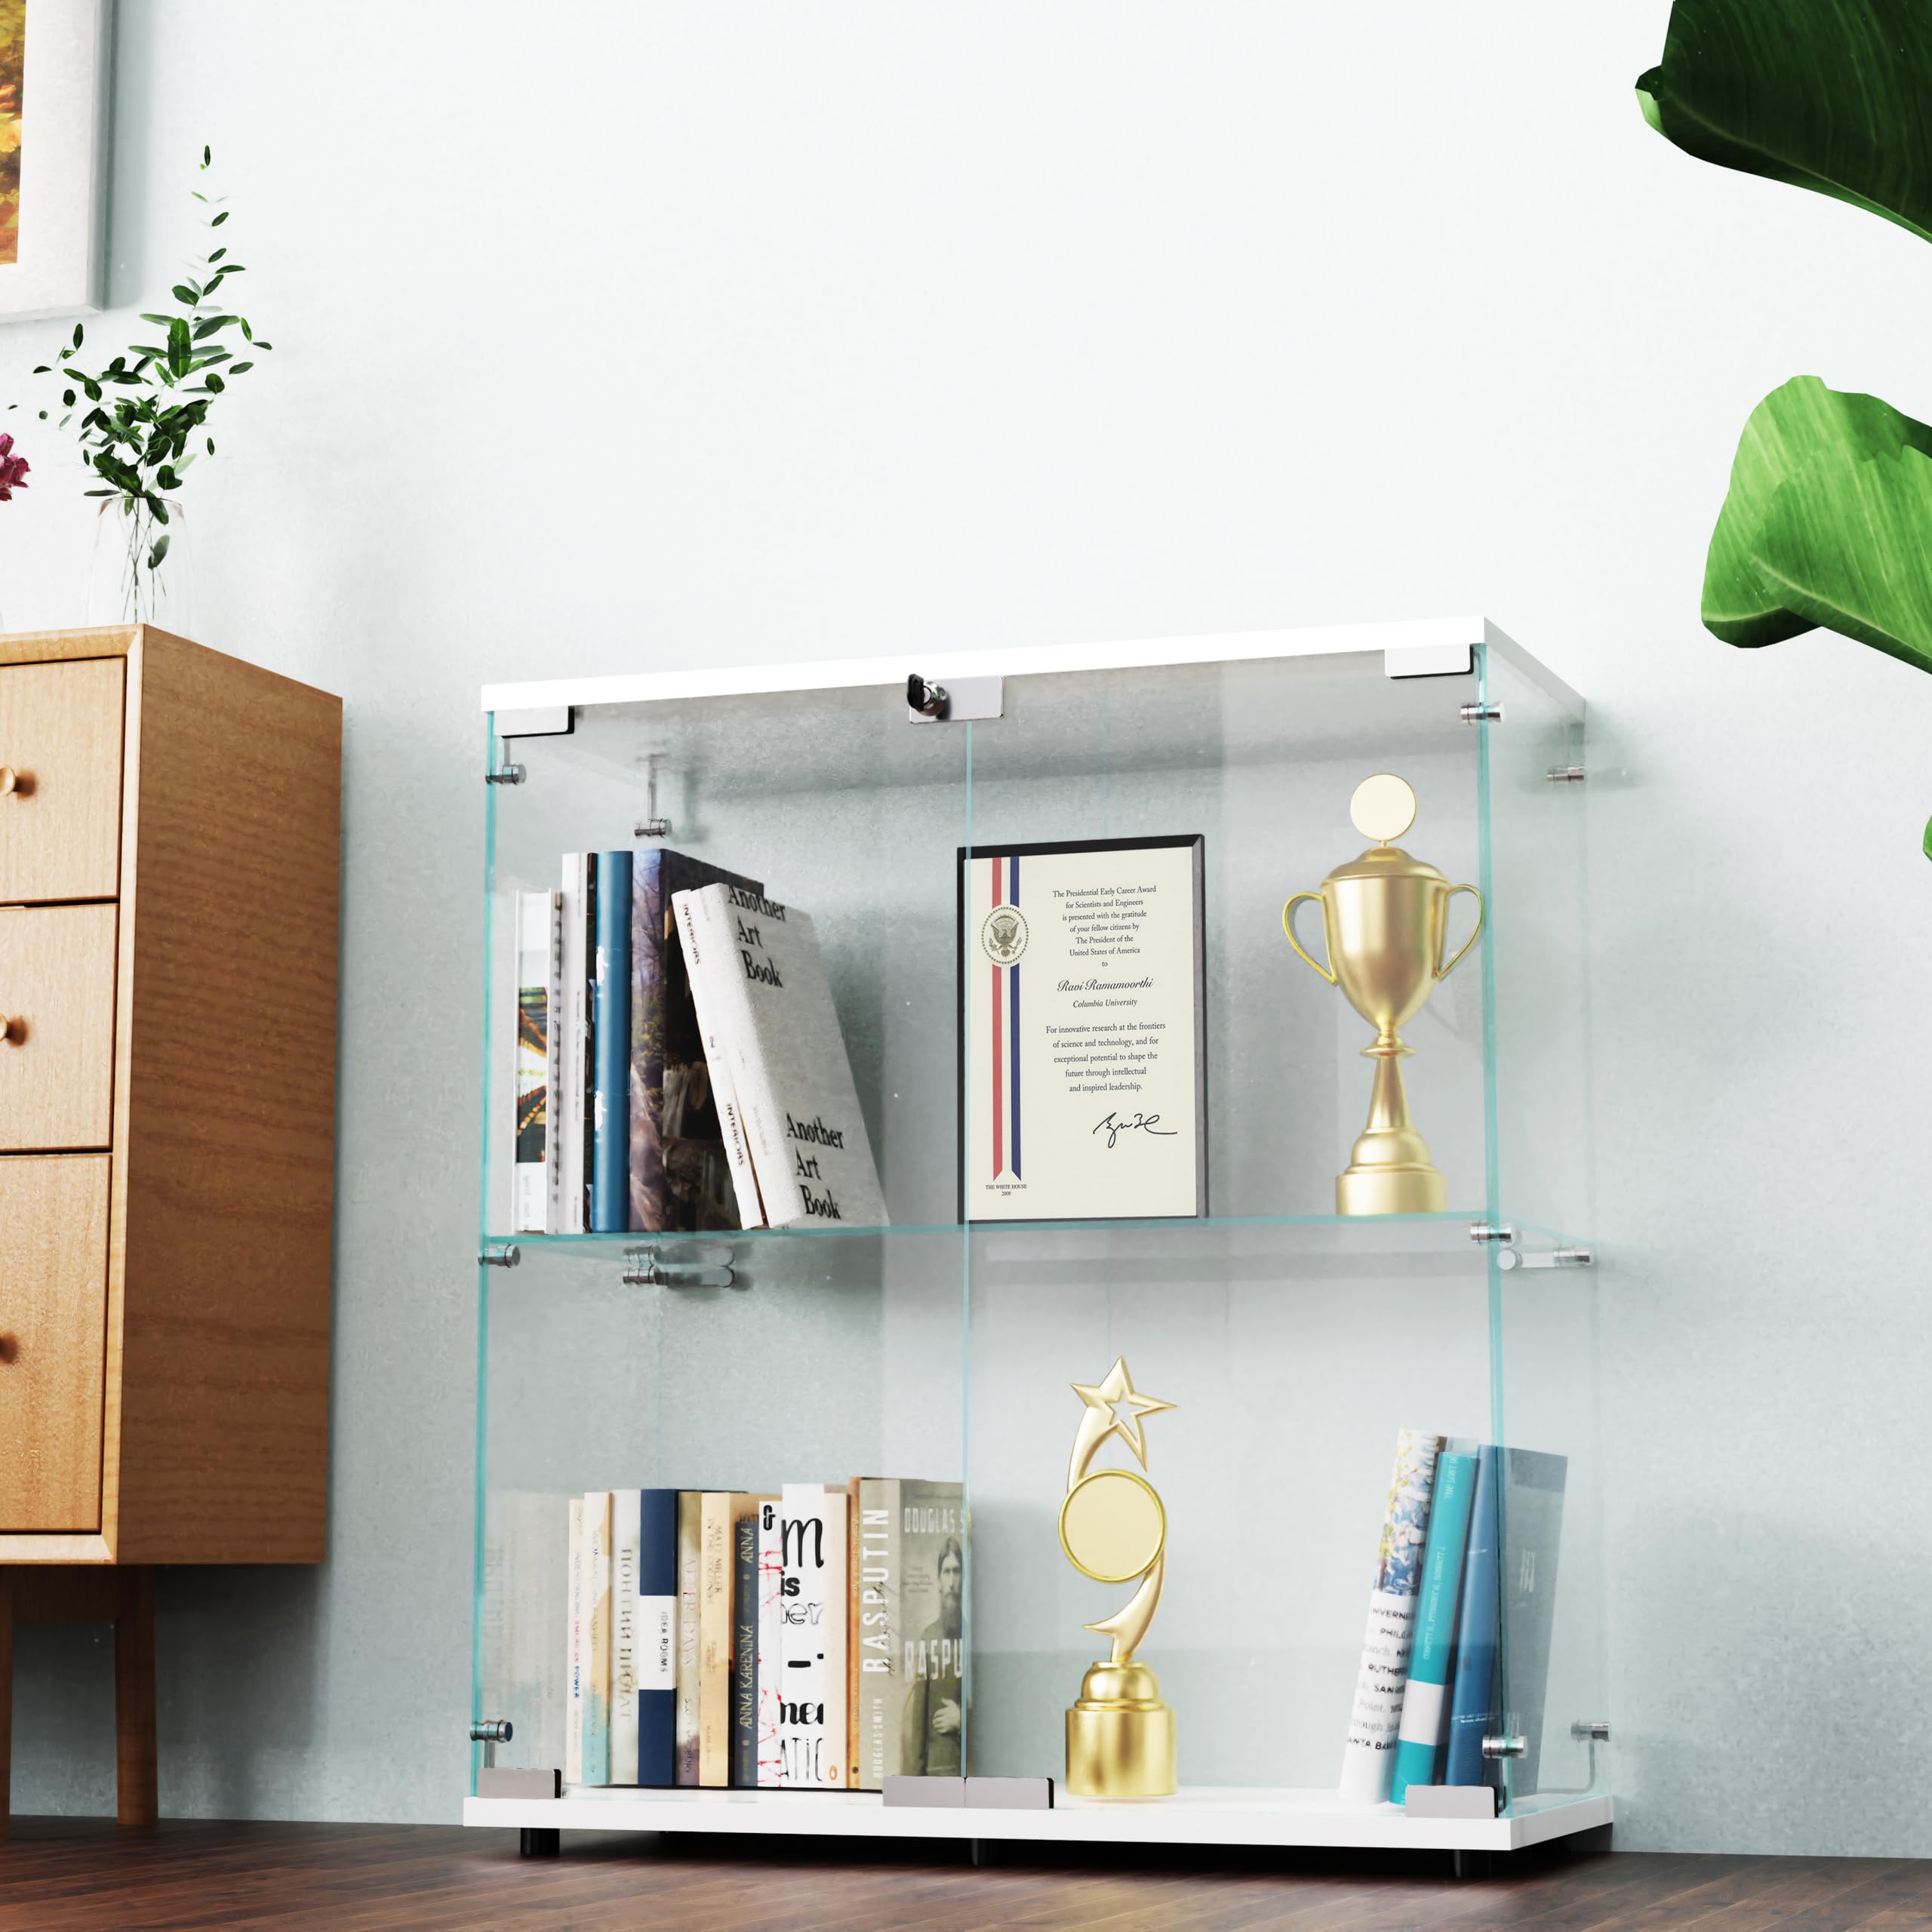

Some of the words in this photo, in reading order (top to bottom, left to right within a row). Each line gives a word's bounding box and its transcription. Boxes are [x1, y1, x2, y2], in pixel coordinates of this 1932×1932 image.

[728, 884, 786, 922] Another
[1066, 888, 1098, 897] Presidential
[1100, 888, 1115, 897] Early
[1115, 899, 1143, 908] Engineers
[737, 915, 764, 949] Art
[1069, 912, 1094, 922] presented
[1121, 910, 1146, 919] gratitude
[683, 903, 700, 964] INTERIORS
[742, 949, 784, 988] Book
[1069, 948, 1088, 956] United
[1057, 980, 1084, 992] Ravi
[1085, 977, 1154, 990] Ramamoorthi
[1106, 998, 1137, 1007] University
[1092, 1023, 1117, 1032] research
[1139, 1022, 1165, 1030] frontiers
[1098, 1038, 1134, 1048] technology,
[1054, 1054, 1088, 1065] exceptional
[1091, 1053, 1117, 1063] potential
[1128, 1053, 1146, 1062] shape
[1086, 1068, 1110, 1078] through
[1112, 1067, 1146, 1075] intellectual
[1069, 1084, 1080, 1092] and
[1082, 1084, 1107, 1093] inspired
[1109, 1082, 1143, 1092] leadership.
[727, 1103, 745, 1166] INTERIORS
[786, 1112, 844, 1149] Another
[795, 1147, 821, 1180] Art
[800, 1185, 841, 1220] Book
[904, 1508, 955, 1534] DOUGLAS
[740, 1527, 754, 1564] ANNA
[682, 1557, 697, 1614] AFTER
[714, 1558, 722, 1594] MILLER
[863, 1510, 888, 1672] RASPUTIN
[660, 1611, 669, 1634] IDEA
[660, 1638, 669, 1672] ROOMS
[682, 1620, 697, 1666] DAYS
[739, 1625, 753, 1689] KARENINA
[739, 1693, 753, 1730] ANNA
